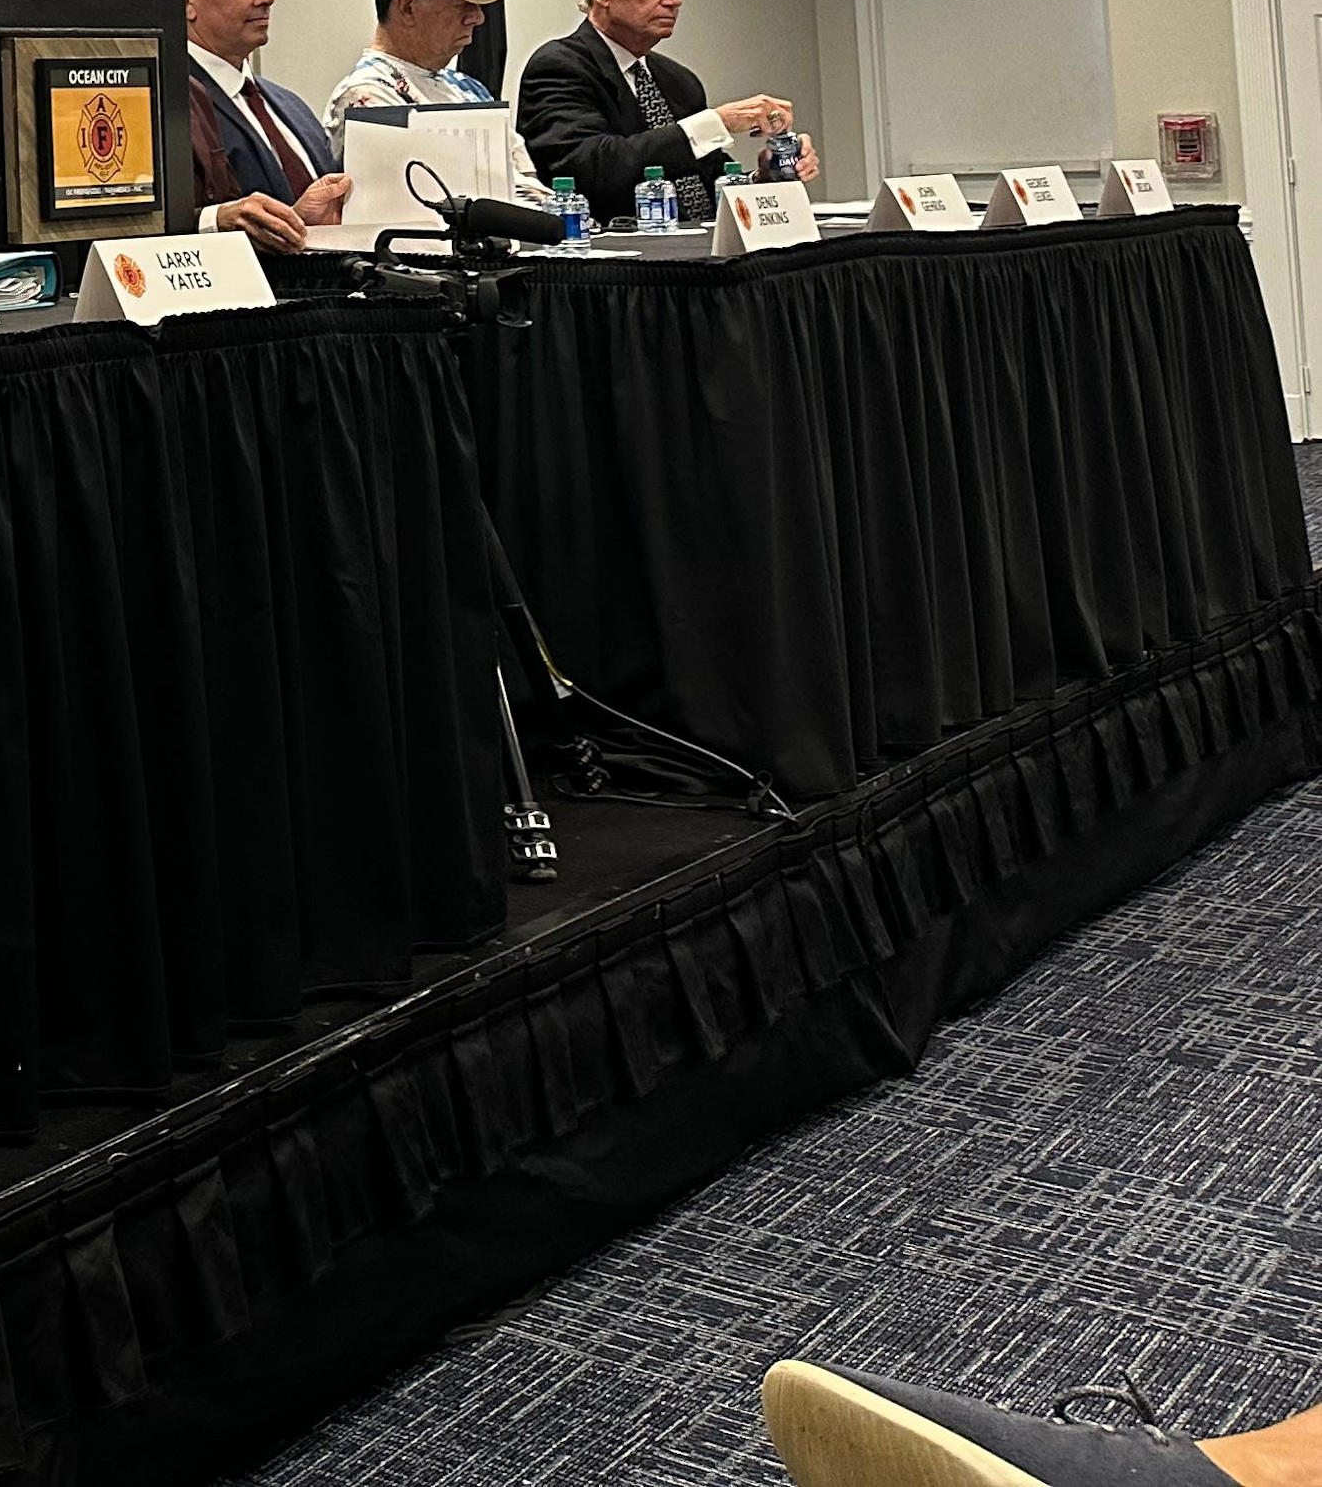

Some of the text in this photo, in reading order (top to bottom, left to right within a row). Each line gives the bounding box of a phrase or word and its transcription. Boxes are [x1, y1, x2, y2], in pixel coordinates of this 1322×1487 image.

[68, 69, 129, 85] OCEAN CITY
[156, 250, 202, 269] LARRY
[165, 271, 212, 291] YATES
